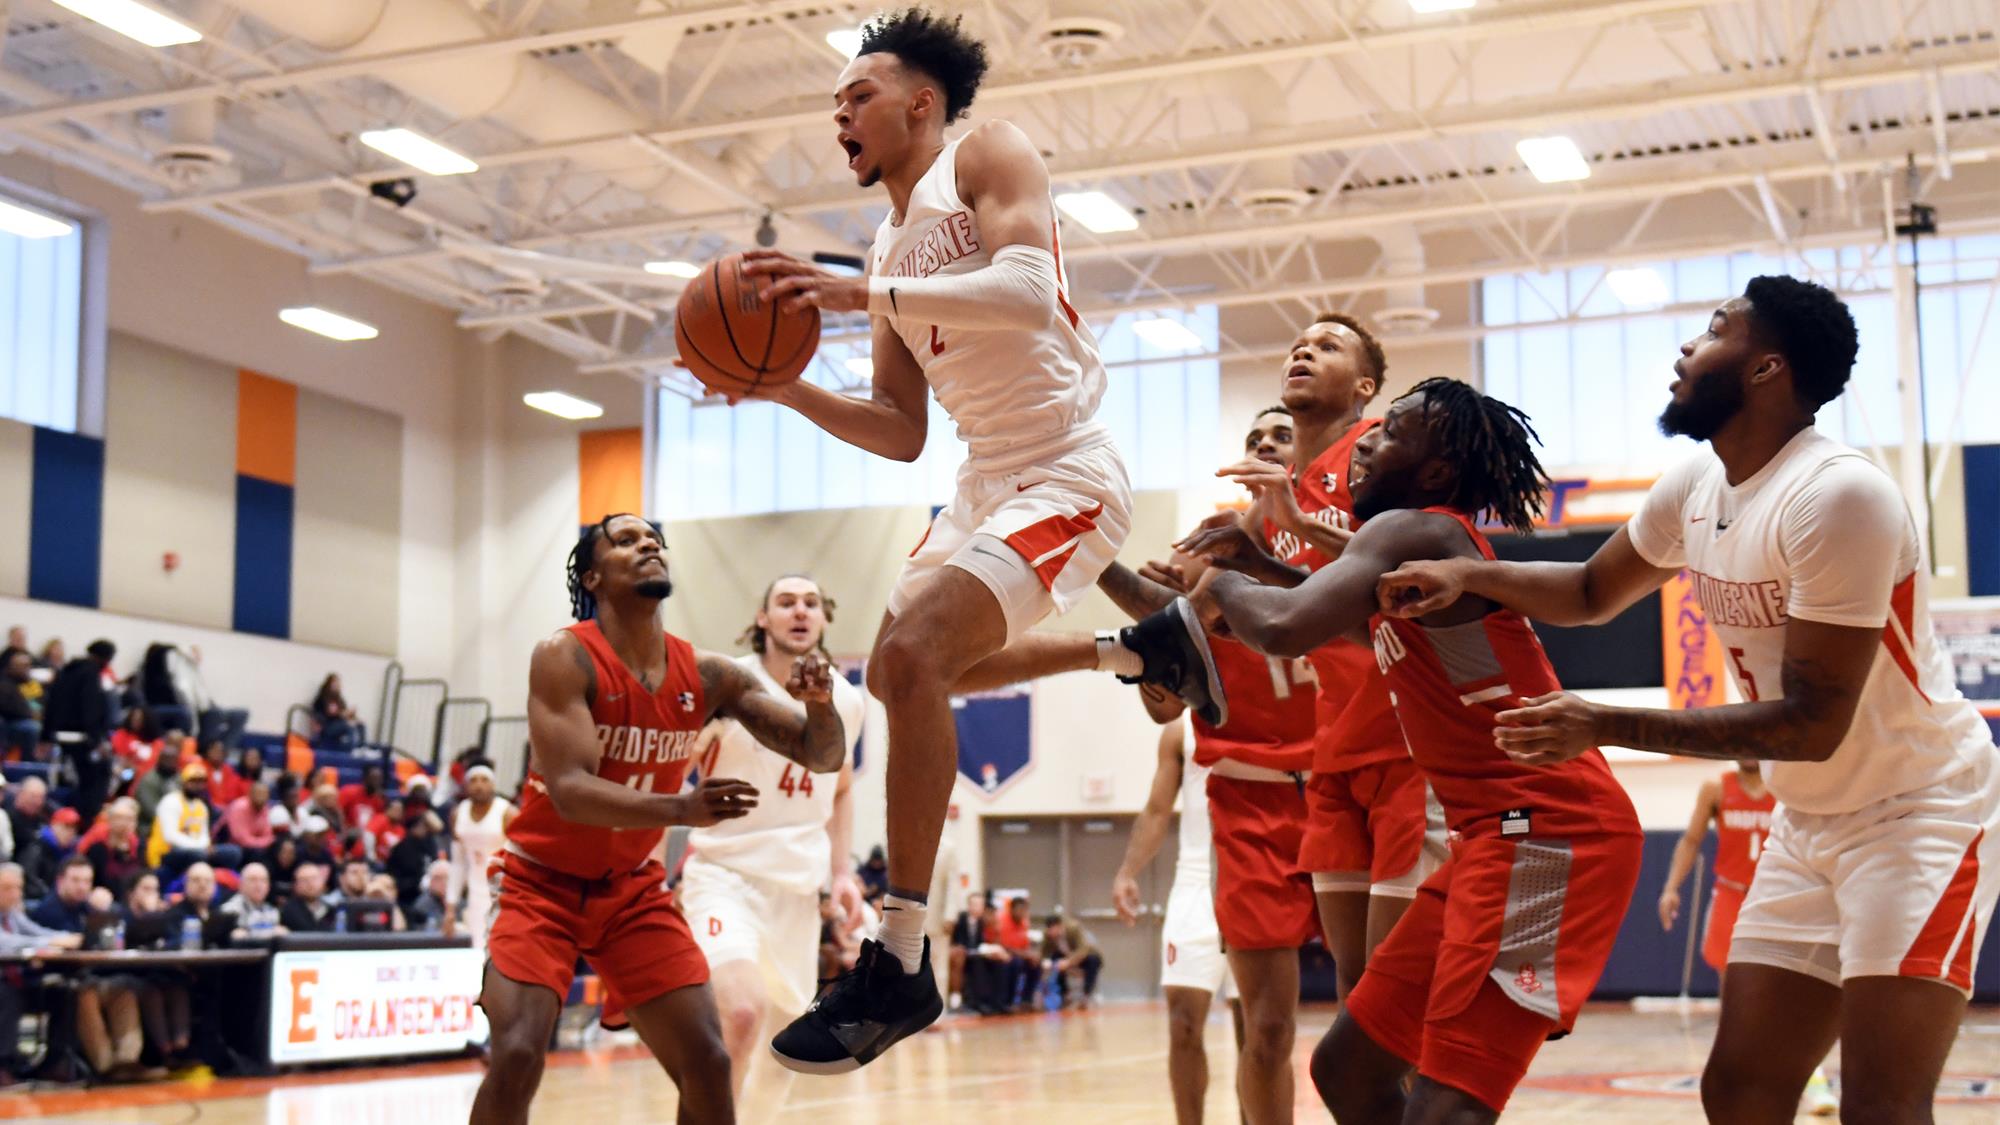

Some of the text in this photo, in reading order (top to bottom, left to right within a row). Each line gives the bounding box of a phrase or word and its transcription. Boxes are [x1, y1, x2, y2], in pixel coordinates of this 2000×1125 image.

[1728, 647, 1760, 702] 5
[778, 762, 813, 798] 44
[709, 917, 722, 936] D
[288, 968, 319, 1043] E
